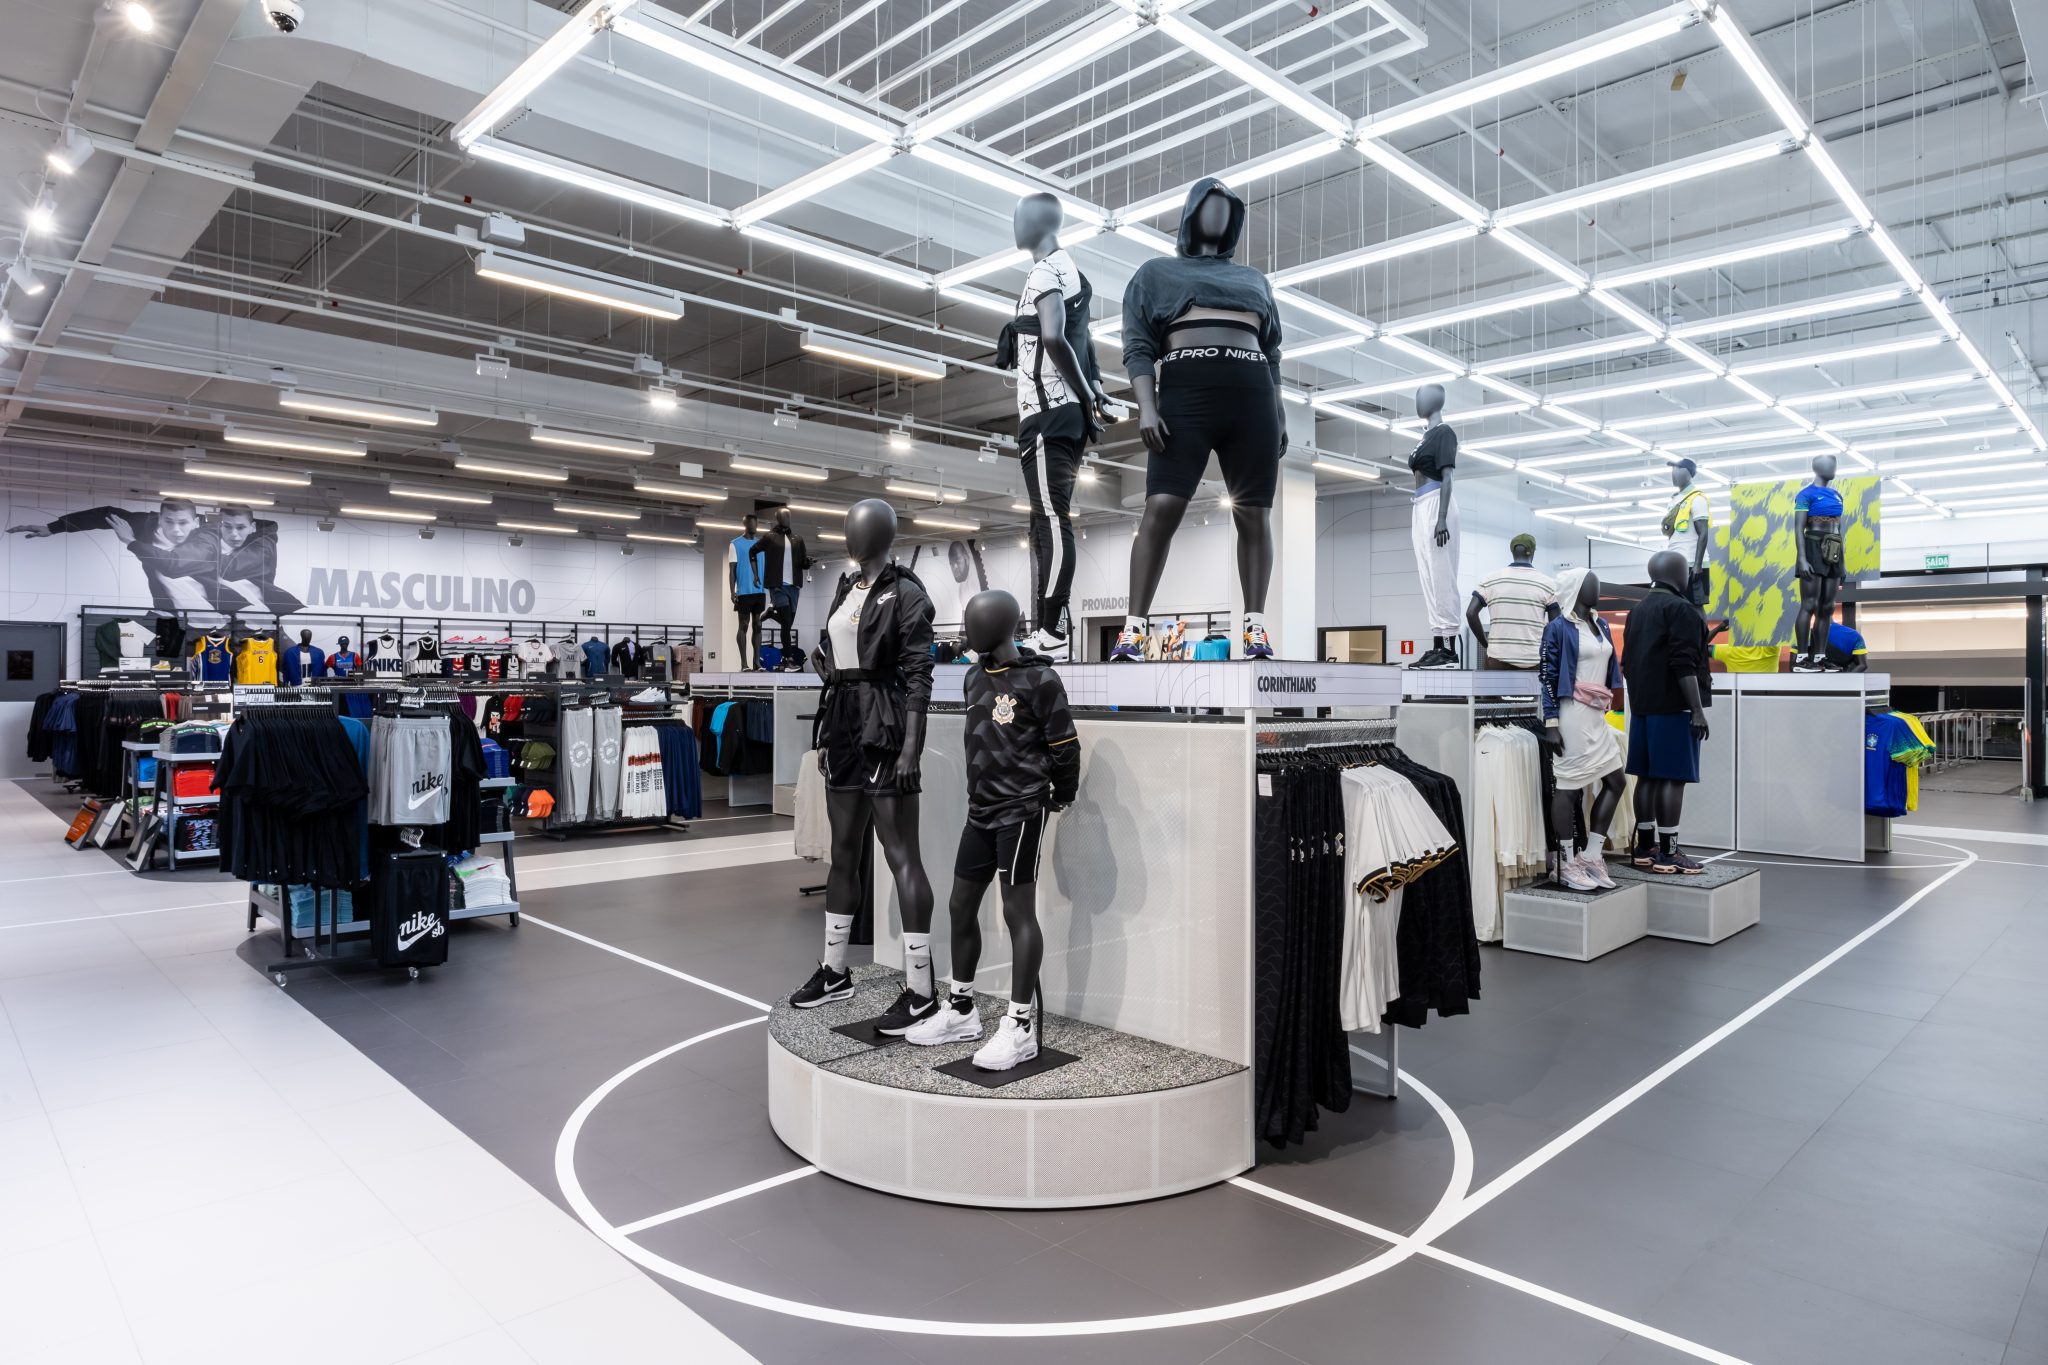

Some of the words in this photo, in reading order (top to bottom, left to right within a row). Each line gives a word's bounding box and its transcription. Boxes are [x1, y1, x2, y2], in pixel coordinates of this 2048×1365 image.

[1180, 347, 1219, 359] PRO
[1225, 348, 1258, 361] NIKE
[1926, 556, 1949, 567] SAÍDA
[307, 567, 536, 615] MASCULINO
[258, 656, 264, 664] 6
[414, 660, 443, 674] NIKE
[1257, 676, 1317, 693] CORINTHIANS
[412, 772, 444, 795] nike
[399, 911, 435, 937] nike
[431, 921, 445, 938] sb
